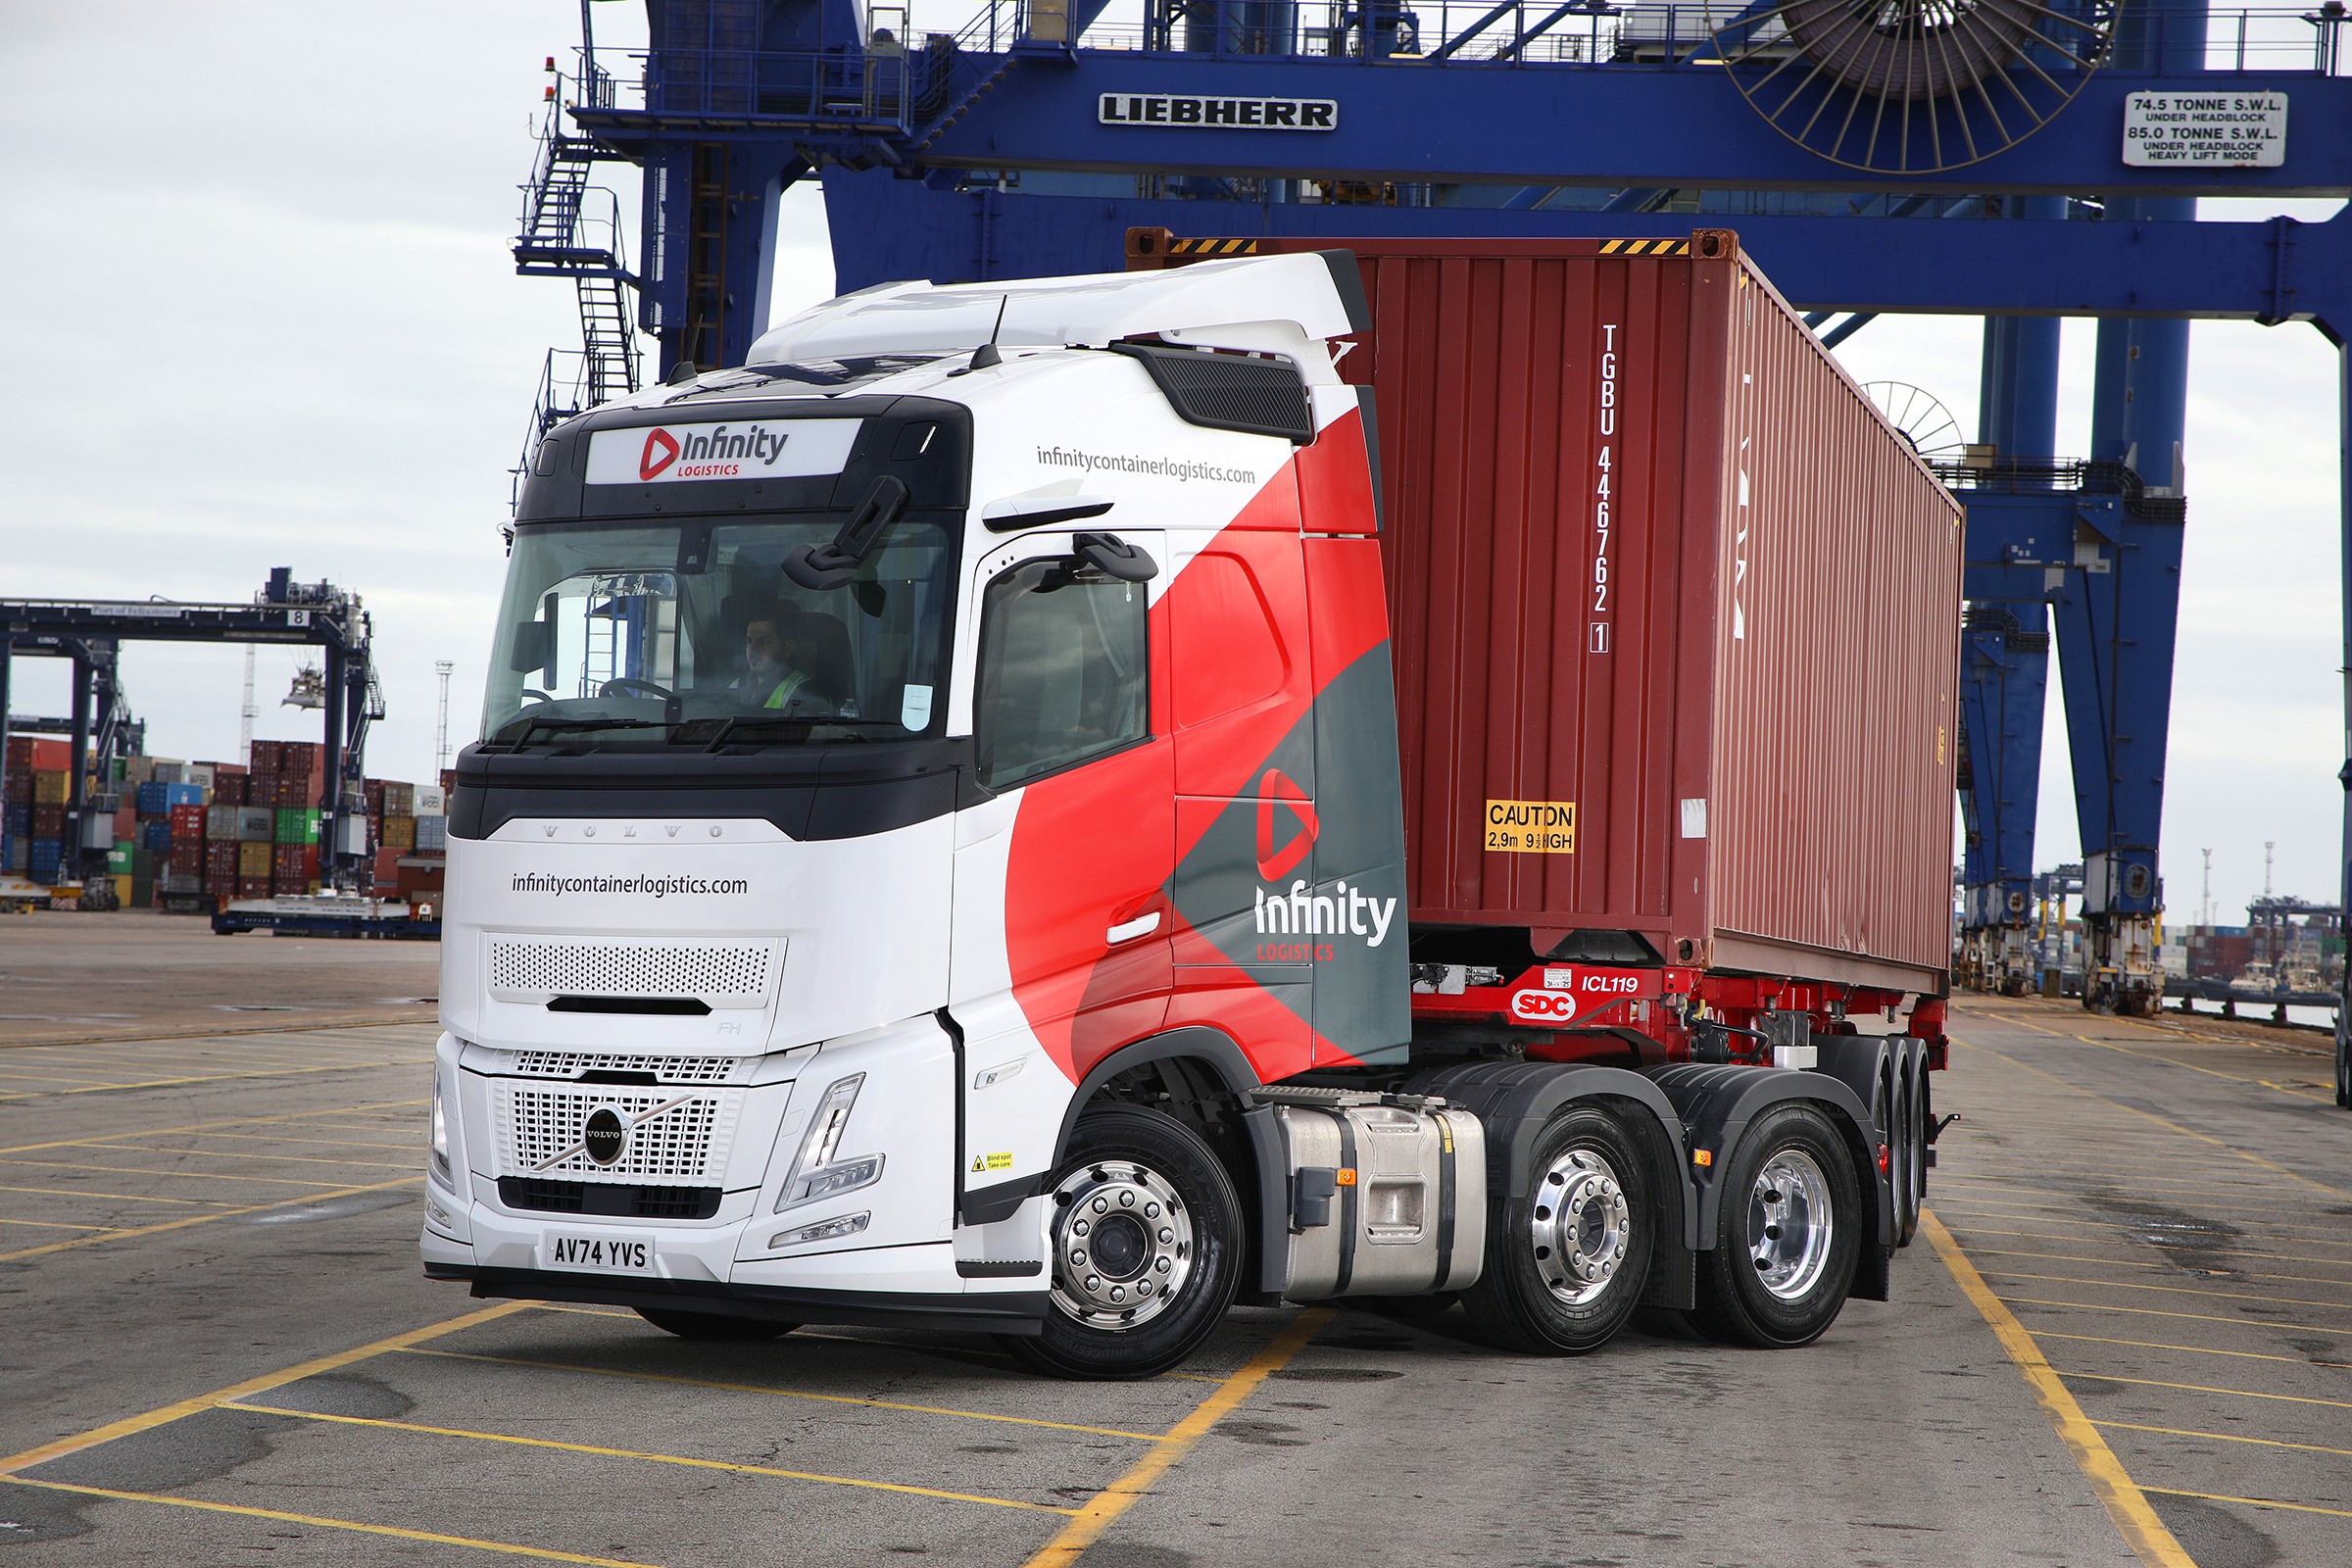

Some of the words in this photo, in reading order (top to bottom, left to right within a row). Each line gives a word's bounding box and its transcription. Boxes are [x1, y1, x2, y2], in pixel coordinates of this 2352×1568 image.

[1103, 96, 1334, 126] LIEBHERR
[2133, 99, 2167, 111] 74.5
[2174, 99, 2227, 111] TONNE
[2233, 99, 2281, 111] S.W.L.
[2128, 127, 2164, 139] 85.0
[2171, 127, 2224, 139] TONNE
[2230, 127, 2278, 139] S.W.L.
[2148, 151, 2188, 160] HEAVY
[2192, 151, 2218, 160] LIFT
[2223, 151, 2258, 160] MODE
[2189, 142, 2264, 151] HEADBLOCK
[1599, 324, 1617, 436] TGBU
[681, 424, 789, 466] Infinity
[677, 465, 739, 477] LOGISTICS
[1037, 445, 1255, 485] infinitycontainerlogistics.com
[1594, 446, 1612, 612] 446762
[293, 611, 304, 625] 8
[1593, 623, 1606, 652] 1
[543, 824, 723, 838] VOLVO
[512, 872, 748, 898] infinitycontainerlogistics.com
[1254, 879, 1397, 948] Infinity
[1582, 976, 1639, 993] ICL119
[1517, 994, 1570, 1016] SDC
[717, 1022, 742, 1035] FH
[587, 1130, 619, 1139] VOLVO
[555, 1238, 602, 1264] AV74
[609, 1241, 646, 1267] YVS
